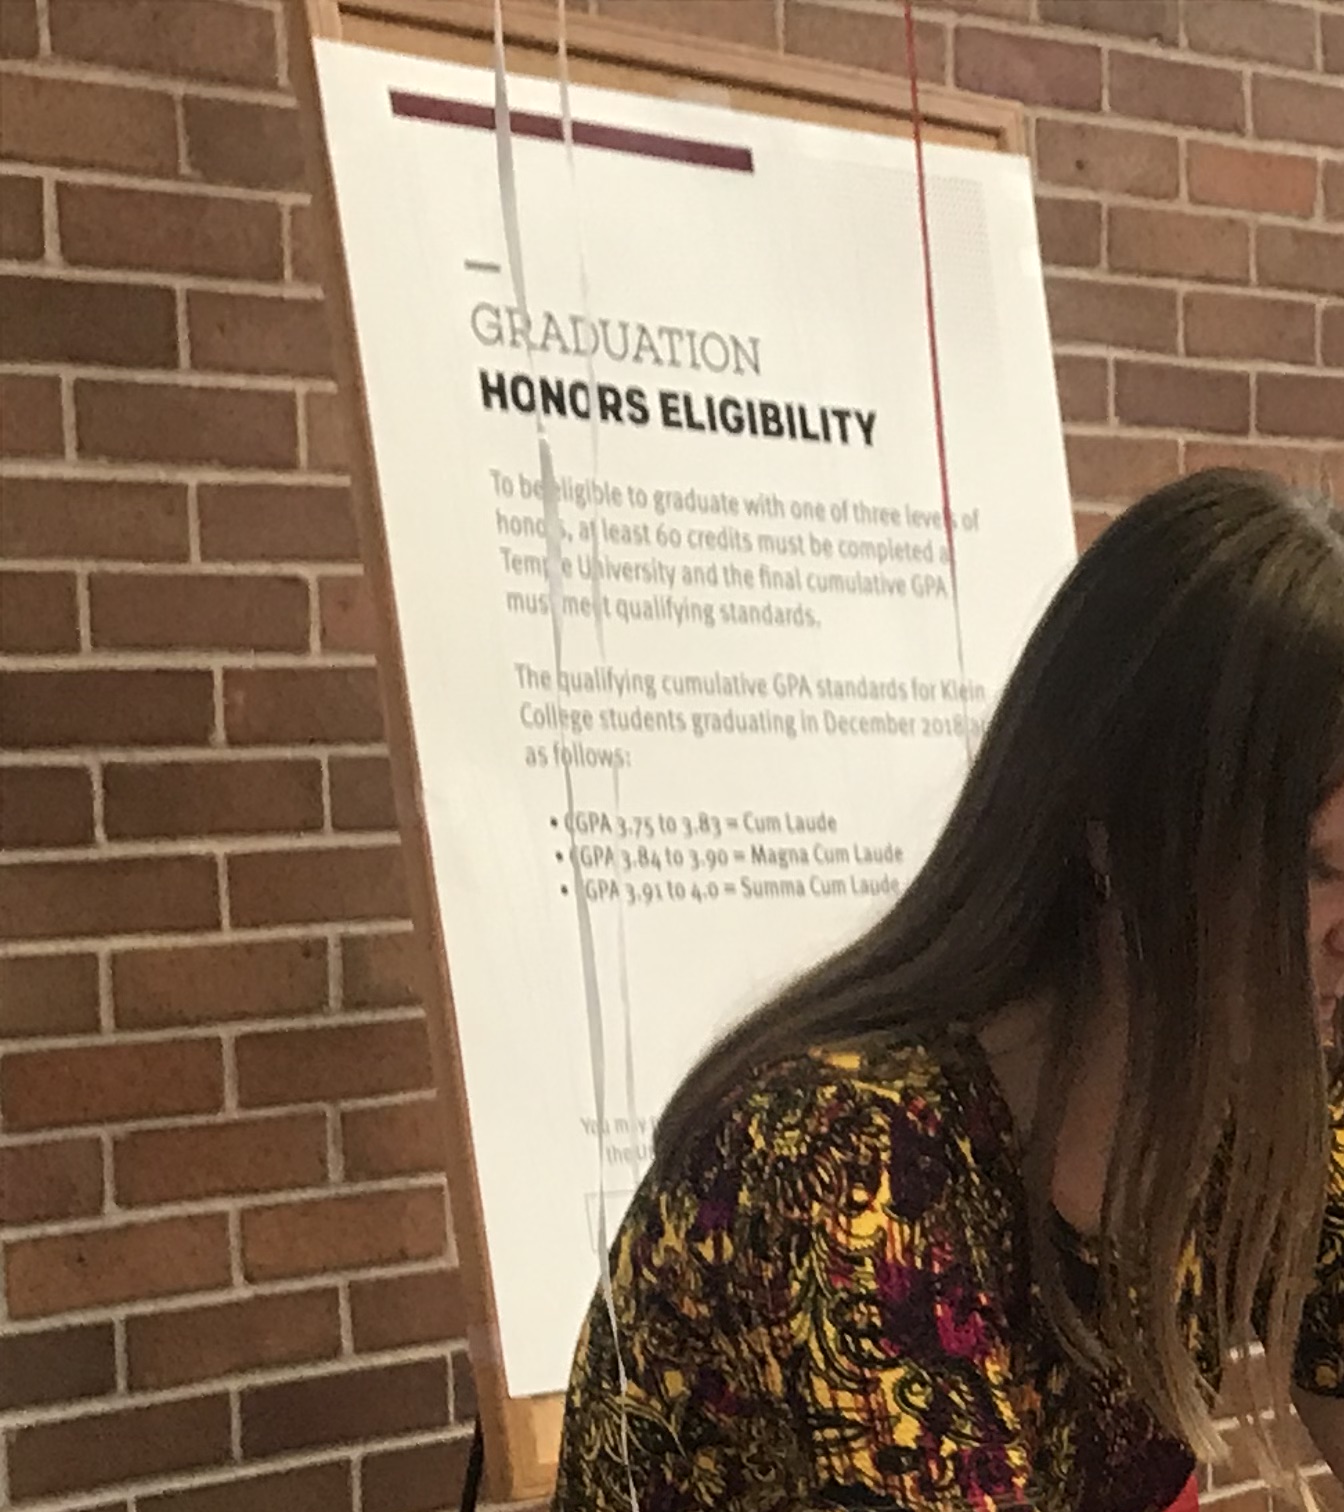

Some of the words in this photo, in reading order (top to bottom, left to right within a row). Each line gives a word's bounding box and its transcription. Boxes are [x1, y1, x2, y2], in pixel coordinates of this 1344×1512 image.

[471, 302, 761, 376] GRADUATION
[480, 370, 650, 426] HONORS
[659, 390, 876, 446] ELIGIBILITY
[489, 469, 514, 497] To
[627, 486, 648, 509] to
[653, 487, 739, 516] graduate
[744, 492, 785, 518] with
[790, 499, 826, 522] one
[830, 499, 848, 524] of
[852, 500, 900, 527] three
[961, 507, 979, 531] of
[496, 508, 573, 543] honos,
[602, 517, 650, 547] least
[656, 522, 682, 549] 60
[687, 525, 752, 552] credits
[757, 533, 804, 556] must
[809, 531, 833, 558] be
[838, 537, 933, 565] completed
[578, 553, 676, 590] University
[682, 563, 718, 587] and
[723, 563, 754, 589] the
[759, 563, 802, 592] final
[806, 570, 906, 597] cumulative
[911, 573, 948, 598] GPA
[506, 591, 554, 616] mus
[562, 595, 611, 620] met
[616, 595, 715, 628] qualifying
[720, 602, 822, 630] standards.
[514, 662, 551, 691] The
[557, 666, 657, 700] qualifying
[662, 670, 768, 698] cumulative
[773, 672, 812, 698] GPA
[816, 674, 908, 701] standards
[911, 676, 936, 702] for
[940, 678, 985, 702] Klein
[520, 701, 593, 735] College
[600, 705, 687, 732] students
[692, 708, 797, 740] graduating
[801, 709, 819, 733] in
[823, 709, 915, 737] December
[921, 713, 966, 738] 2018
[525, 745, 548, 768] as
[553, 740, 632, 769] follows:
[617, 815, 655, 839] 3.75
[659, 813, 677, 835] to
[682, 810, 722, 840] 3.83
[743, 810, 781, 835] Cum
[784, 811, 838, 835] Laude
[621, 845, 661, 872] 3.84
[665, 846, 684, 868] to
[689, 849, 729, 873] 3.90
[751, 844, 810, 870] Magna
[813, 842, 850, 867] Cum
[853, 842, 904, 866] Laude
[625, 881, 662, 906] 3.91
[667, 880, 686, 902] to
[691, 881, 719, 904] 4.0
[740, 875, 806, 900] Summa
[809, 874, 846, 898] Cum
[850, 873, 900, 897] Laude
